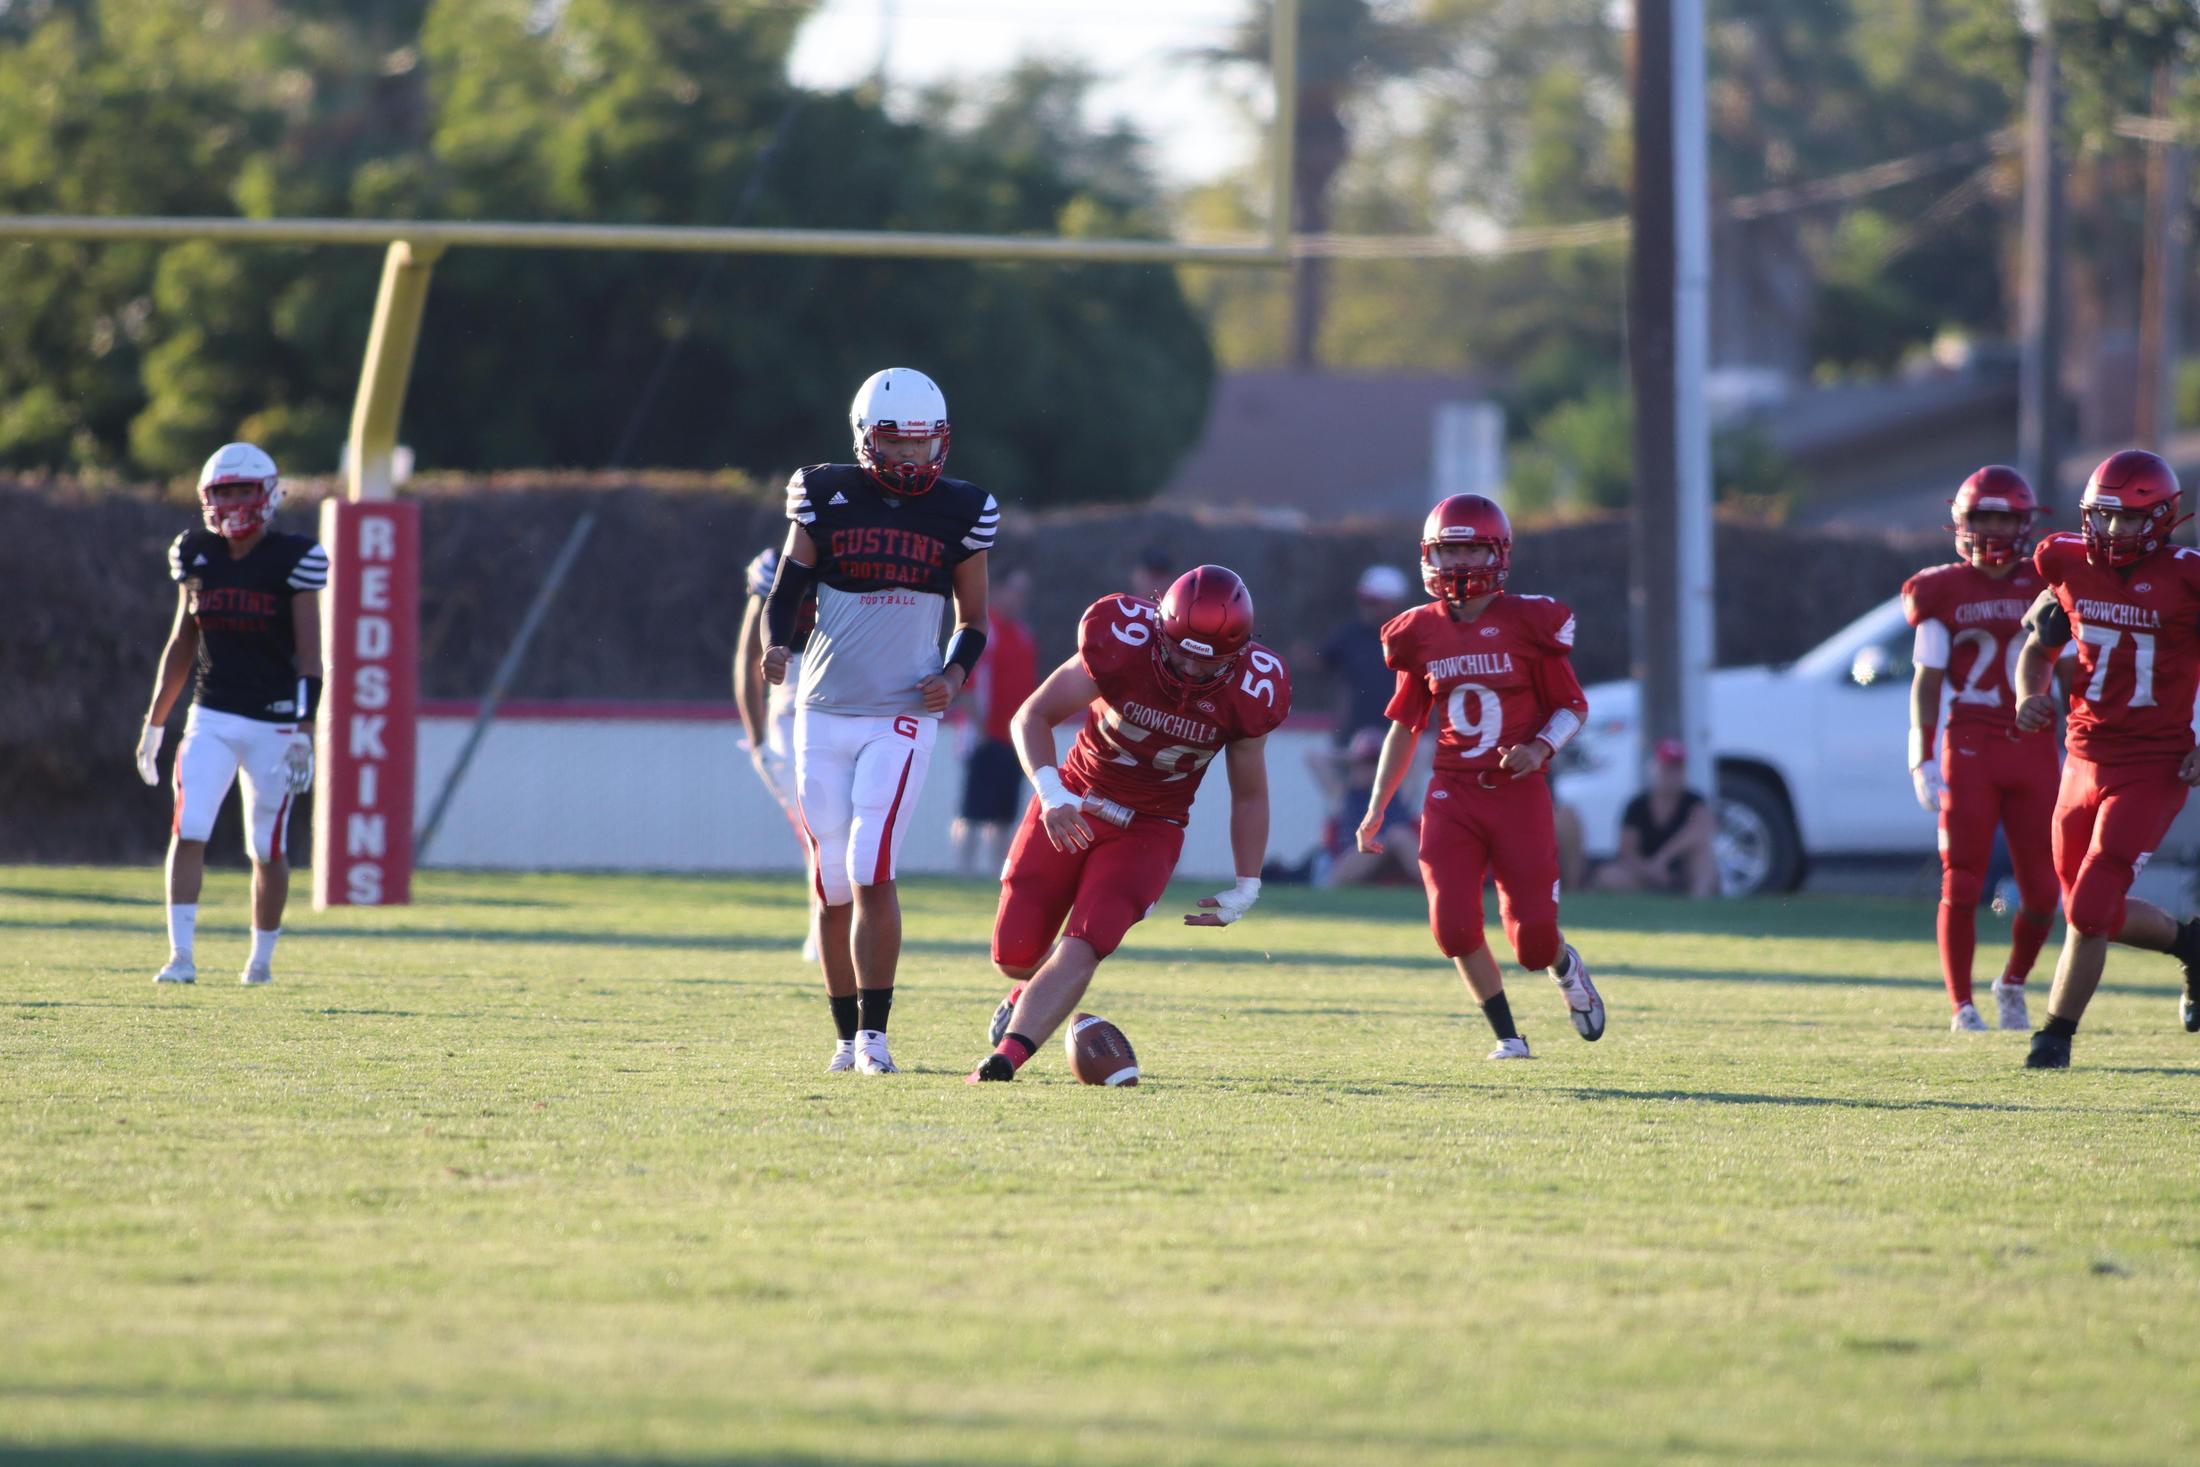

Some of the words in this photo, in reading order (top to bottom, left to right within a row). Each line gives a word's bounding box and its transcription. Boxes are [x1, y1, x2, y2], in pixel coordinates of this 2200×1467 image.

[831, 527, 945, 567] GUSTINE
[197, 588, 277, 615] USTINE
[860, 596, 916, 605] FOOTBALL
[2075, 599, 2162, 628] CHOWCHILLA
[1111, 598, 1154, 646] 59
[1240, 651, 1283, 708] 59
[2078, 622, 2158, 707] 71
[346, 514, 397, 904] REDSKINS
[893, 715, 919, 740] G
[1123, 701, 1217, 743] CHOWCHILLA
[1448, 683, 1503, 759] 9
